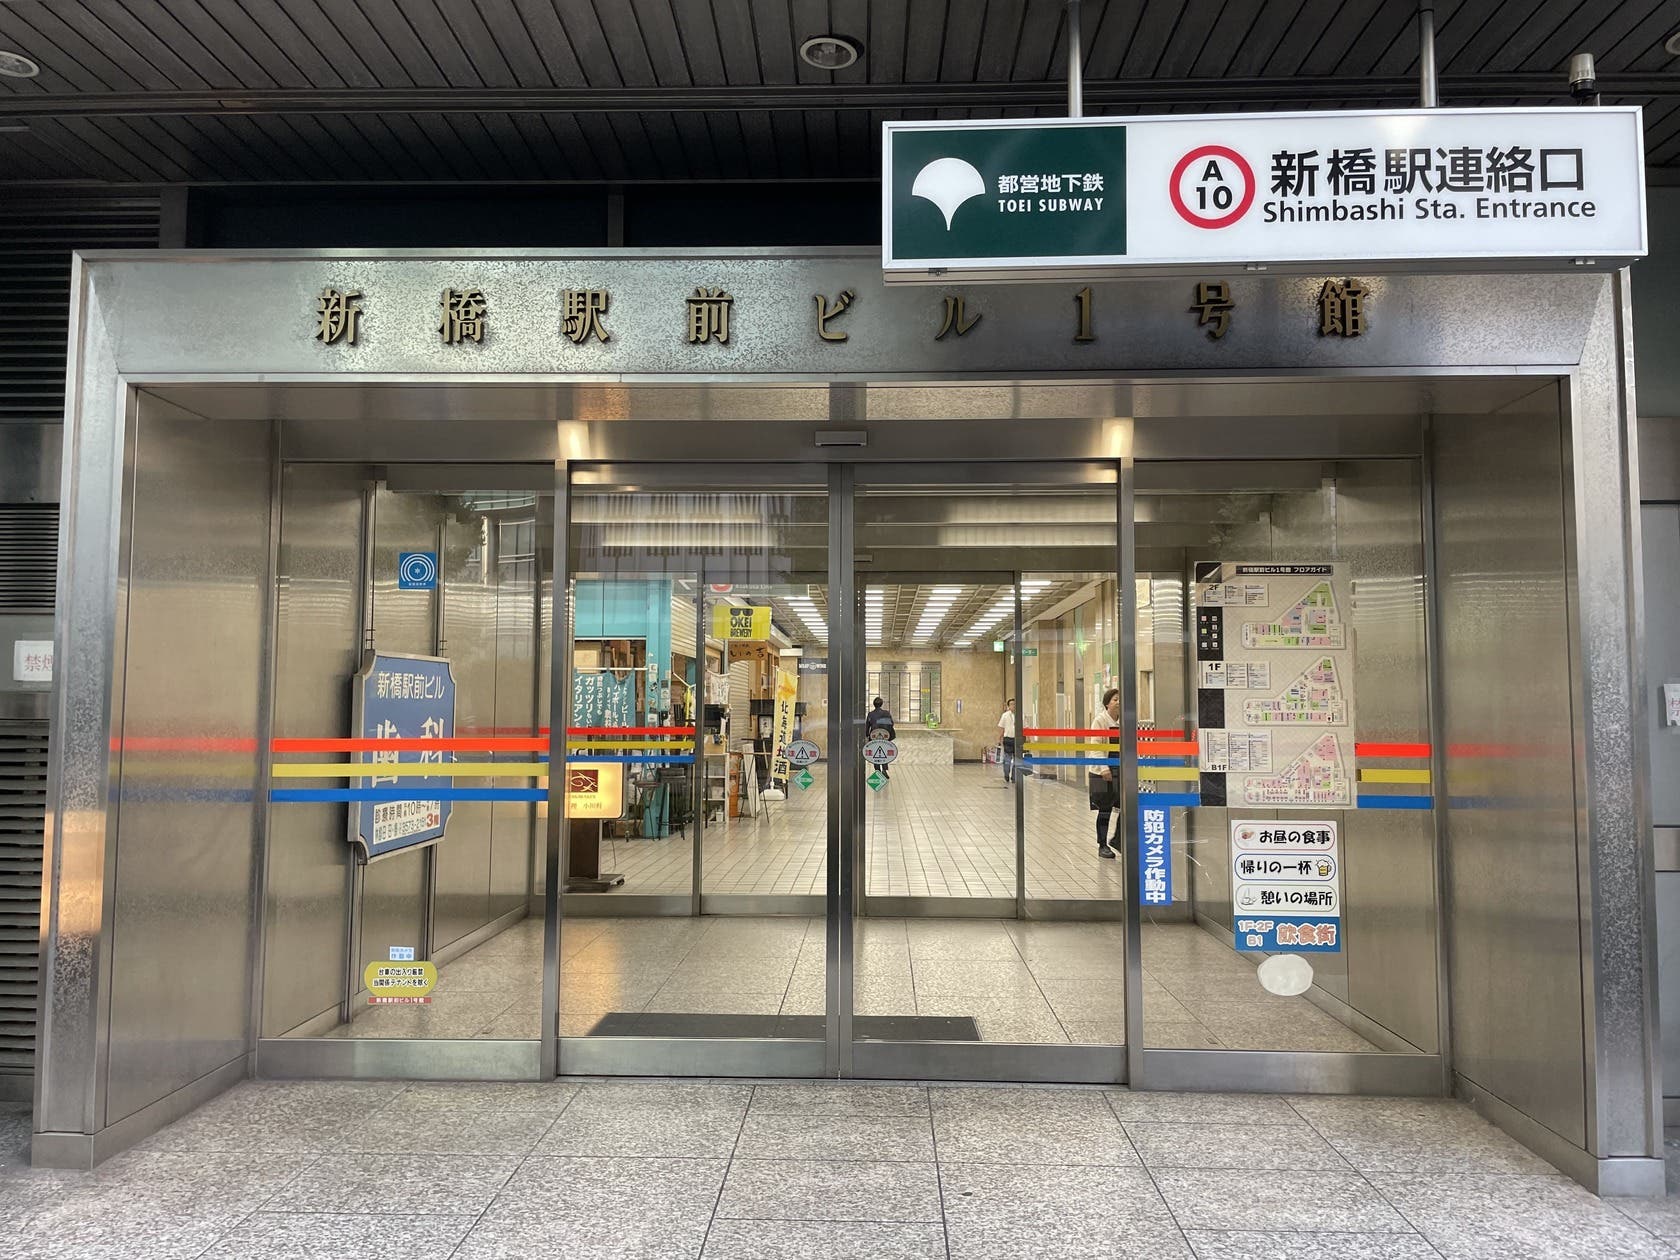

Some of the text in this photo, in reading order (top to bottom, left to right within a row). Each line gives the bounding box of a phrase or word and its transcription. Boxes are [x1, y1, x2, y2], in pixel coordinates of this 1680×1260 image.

[1202, 160, 1224, 181] A
[1270, 147, 1585, 197] 新橋駅連絡口
[998, 172, 1104, 194] 都営地下鉄
[998, 198, 1104, 213] TOEI SUBWAY
[1196, 187, 1233, 210] 10
[1263, 198, 1596, 223] Shimbashi Sta. Entrance
[730, 617, 752, 628] OKEI
[730, 628, 753, 638] BREWERY
[1208, 663, 1221, 671] 1F
[377, 671, 445, 700] 新橋駅前ビル
[1259, 830, 1331, 845] お昼の食事
[1143, 809, 1166, 903] 防犯カメラ作動中
[1240, 860, 1312, 875] 帰りの一杯
[1261, 890, 1333, 906] 憩いの場所
[1246, 934, 1264, 947] B1
[1276, 923, 1336, 947] 飲食街
